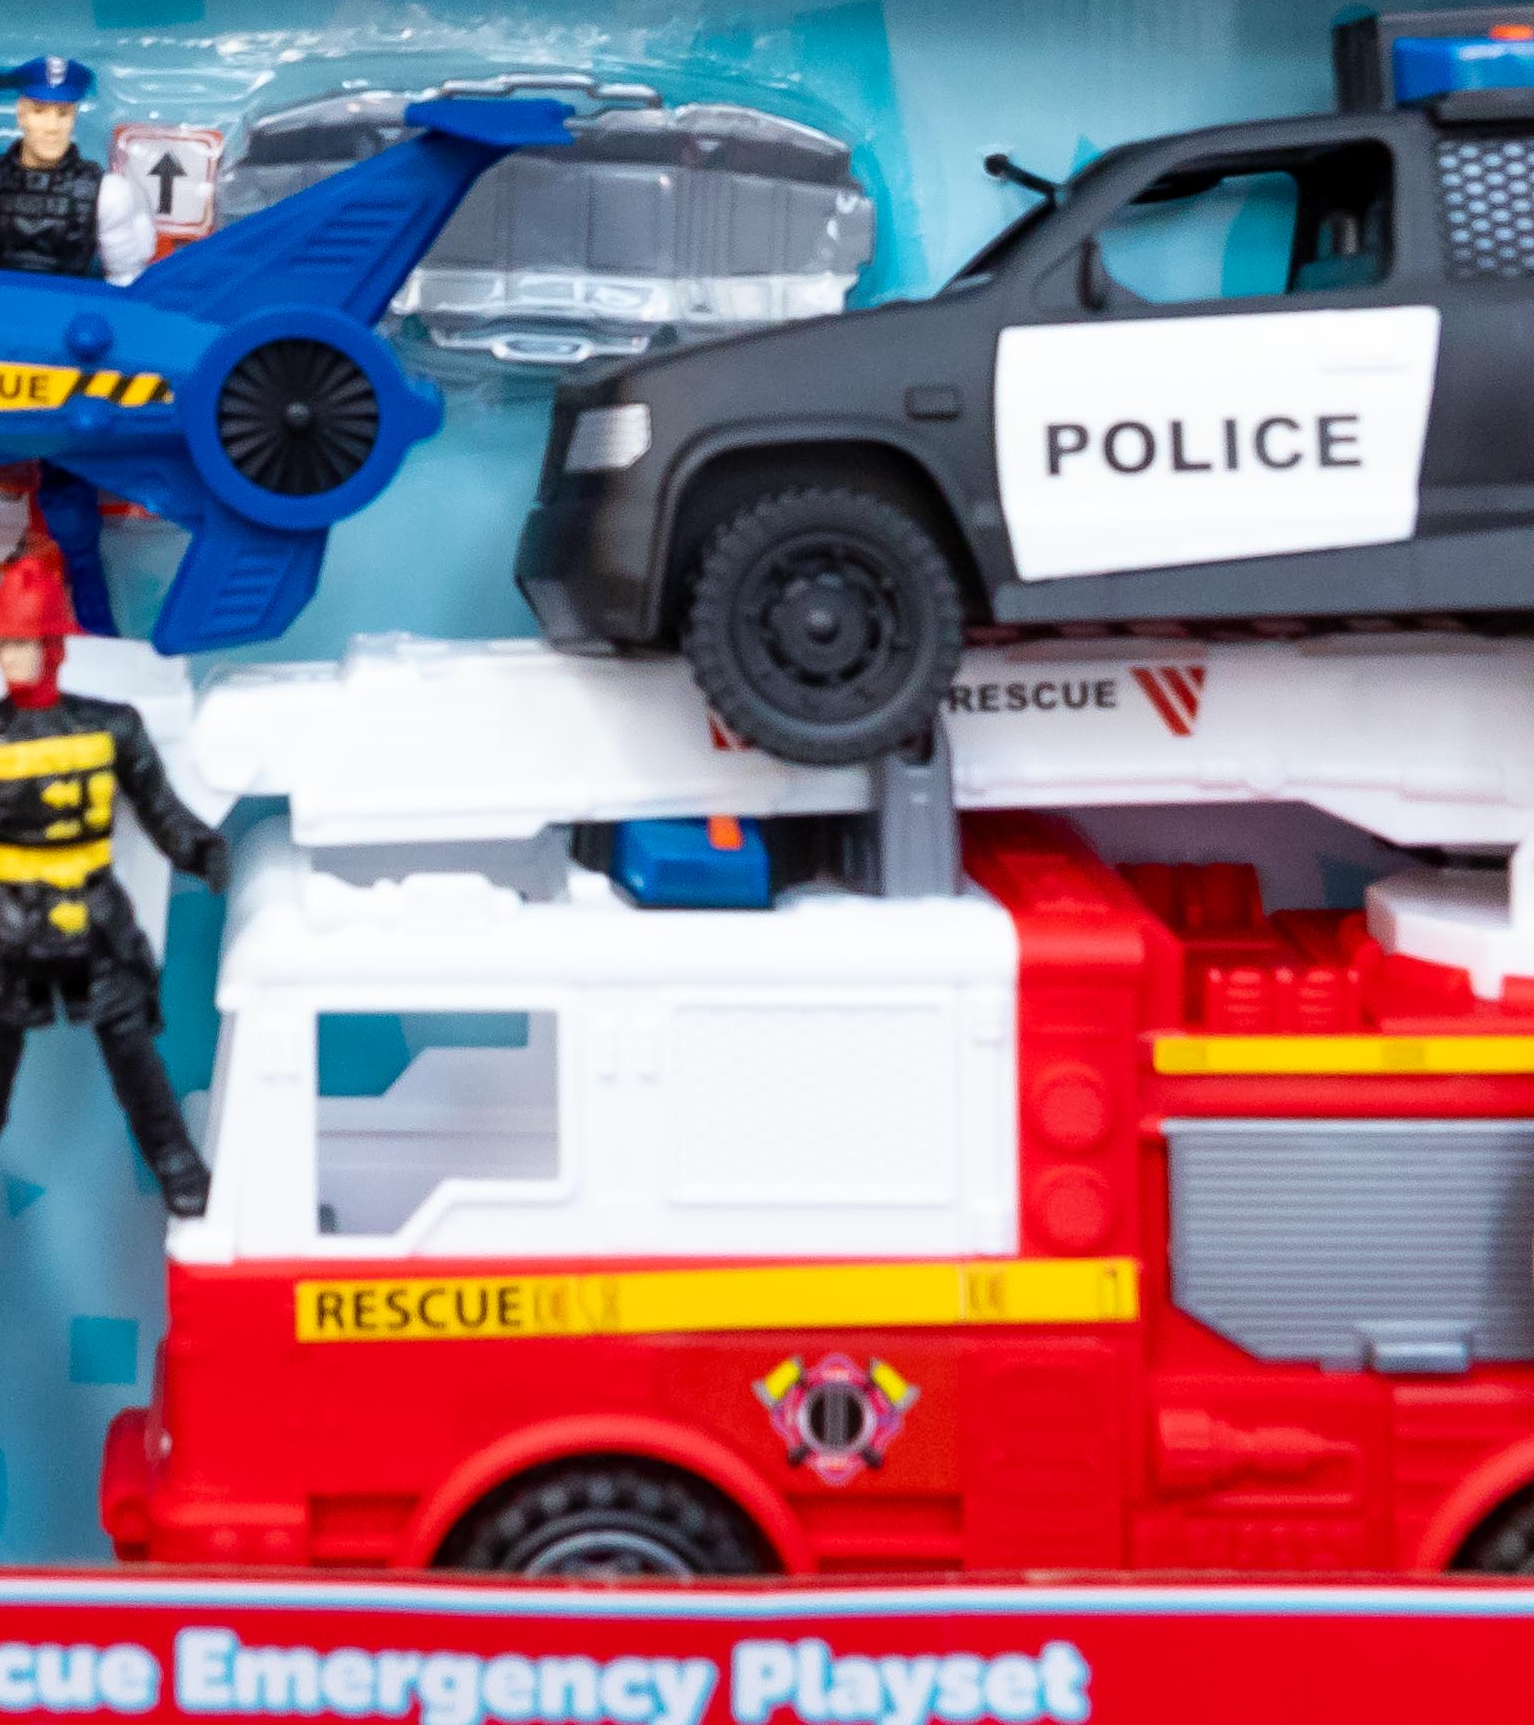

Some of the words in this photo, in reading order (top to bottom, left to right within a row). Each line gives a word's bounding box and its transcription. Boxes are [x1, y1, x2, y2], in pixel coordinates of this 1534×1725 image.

[1045, 413, 1365, 477] POLICE
[946, 678, 1118, 716] RESCUE
[317, 1284, 522, 1332] RESCUE
[174, 1625, 716, 1725] Emergency
[731, 1634, 1092, 1725] Playset
